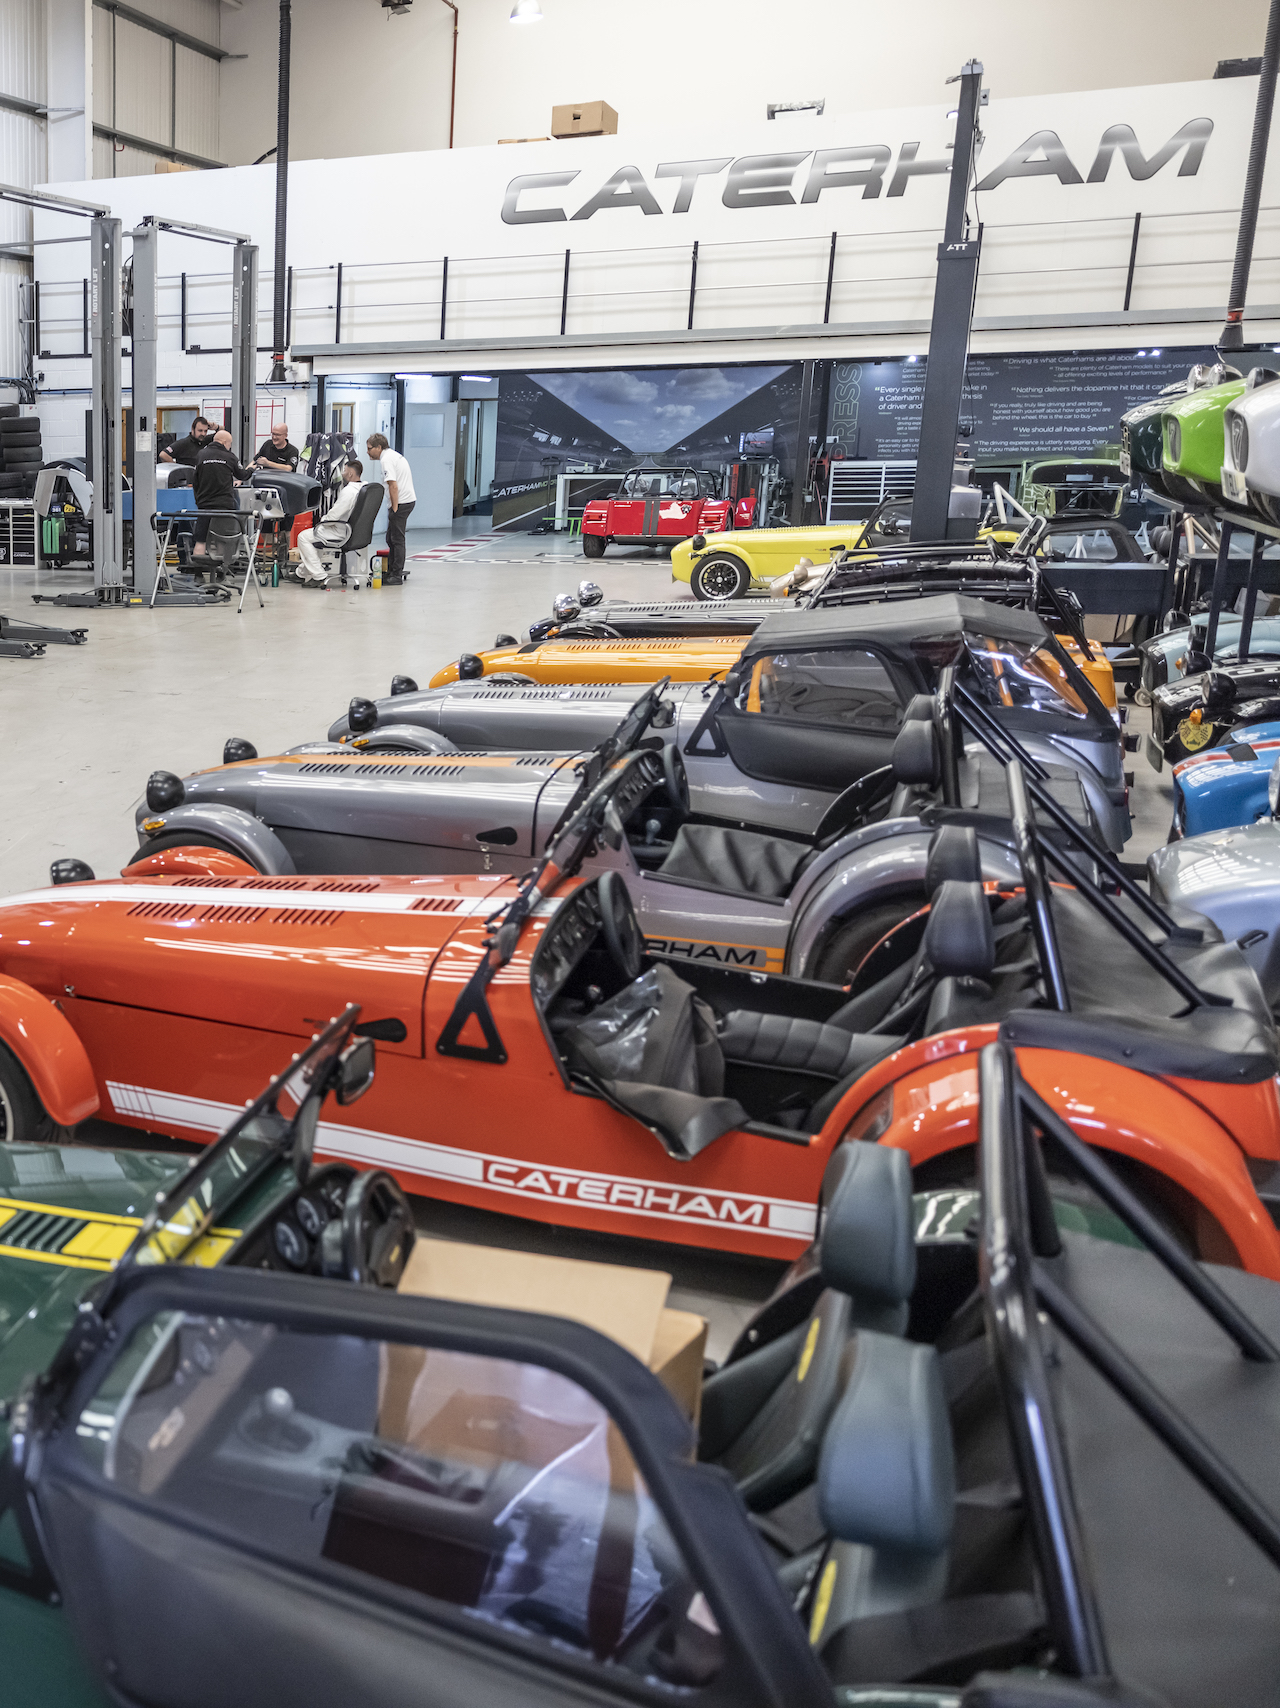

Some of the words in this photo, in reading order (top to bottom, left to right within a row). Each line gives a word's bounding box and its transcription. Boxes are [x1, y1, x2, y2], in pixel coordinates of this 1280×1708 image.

[501, 117, 1214, 225] CATERHAM
[829, 363, 862, 456] PRESS
[646, 939, 757, 965] RHAM
[487, 1162, 764, 1226] CATERHAM
